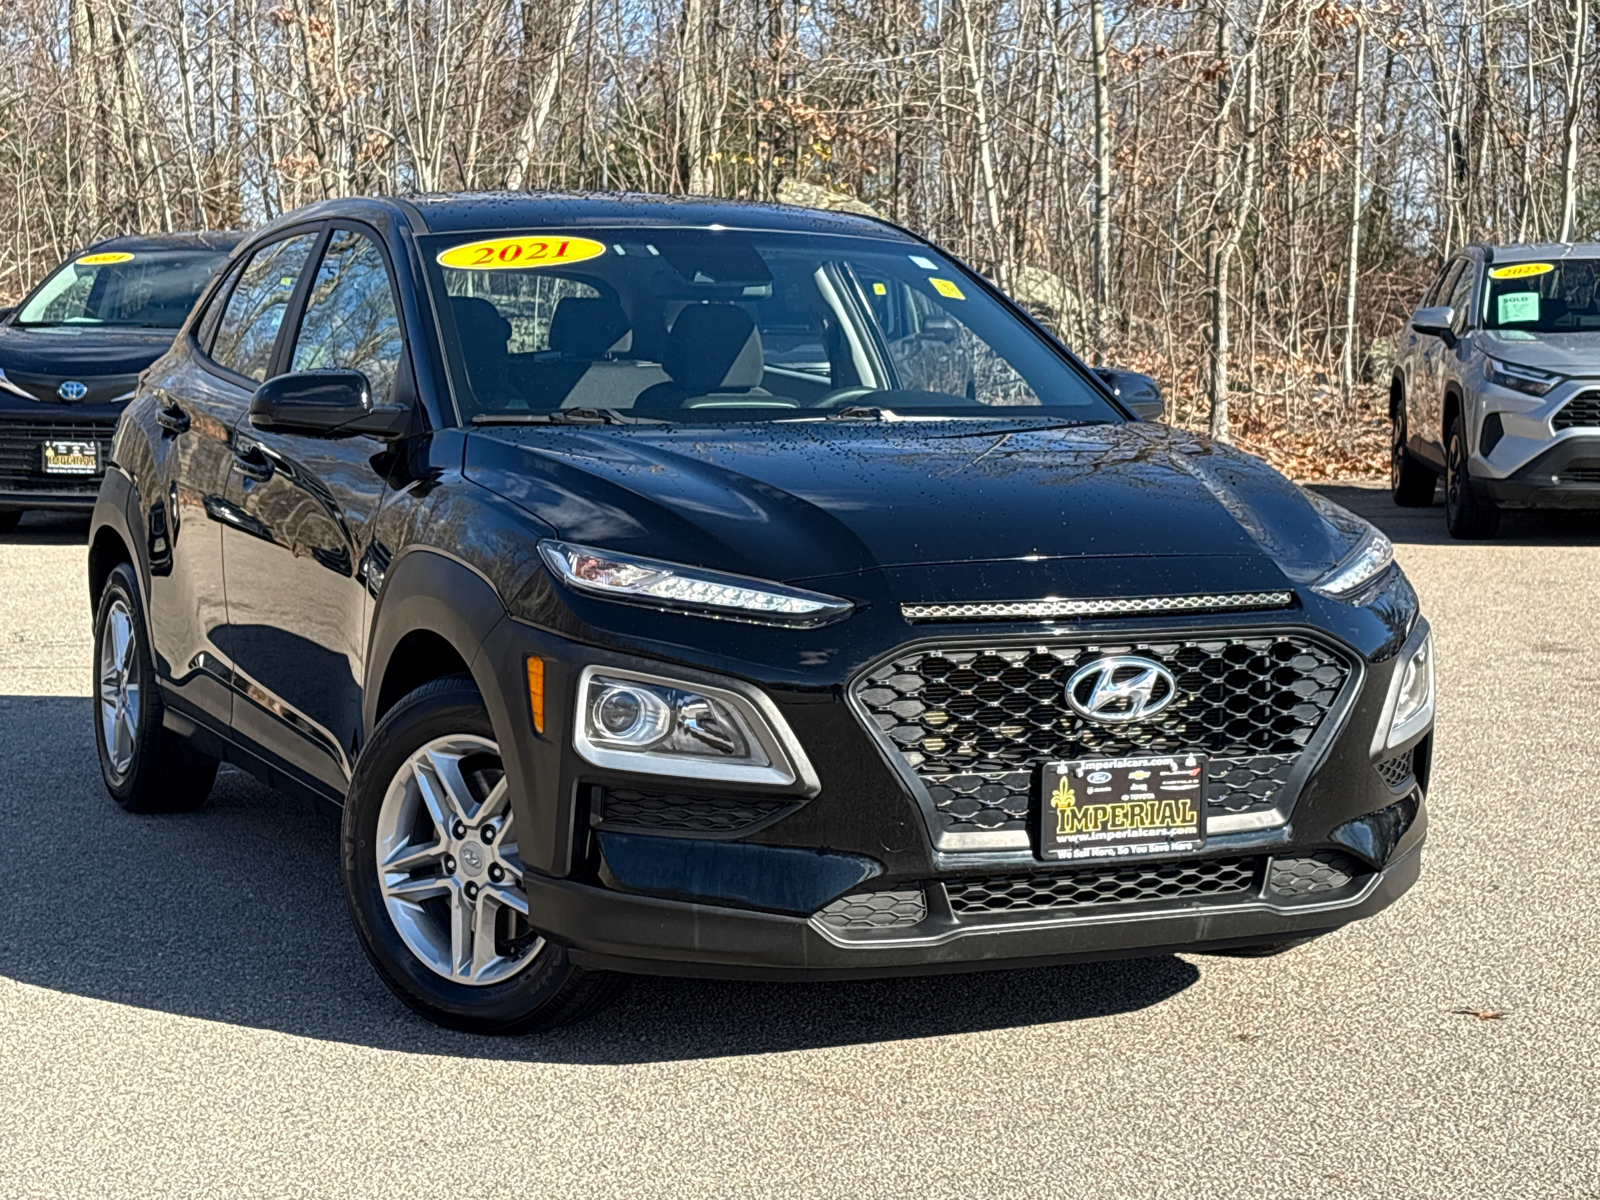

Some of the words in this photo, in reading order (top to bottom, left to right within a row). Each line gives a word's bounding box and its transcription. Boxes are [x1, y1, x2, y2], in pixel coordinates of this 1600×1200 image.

[471, 241, 570, 264] 2021
[1503, 265, 1541, 276] 2025
[1056, 799, 1198, 834] IMPERIAL
[1056, 826, 1198, 843] www.imperialcars.com
[1057, 849, 1072, 859] We
[1073, 847, 1090, 858] Sell
[1117, 846, 1129, 855] So
[1131, 844, 1148, 853] You
[1149, 843, 1170, 853] Save
[1171, 841, 1193, 851] More
